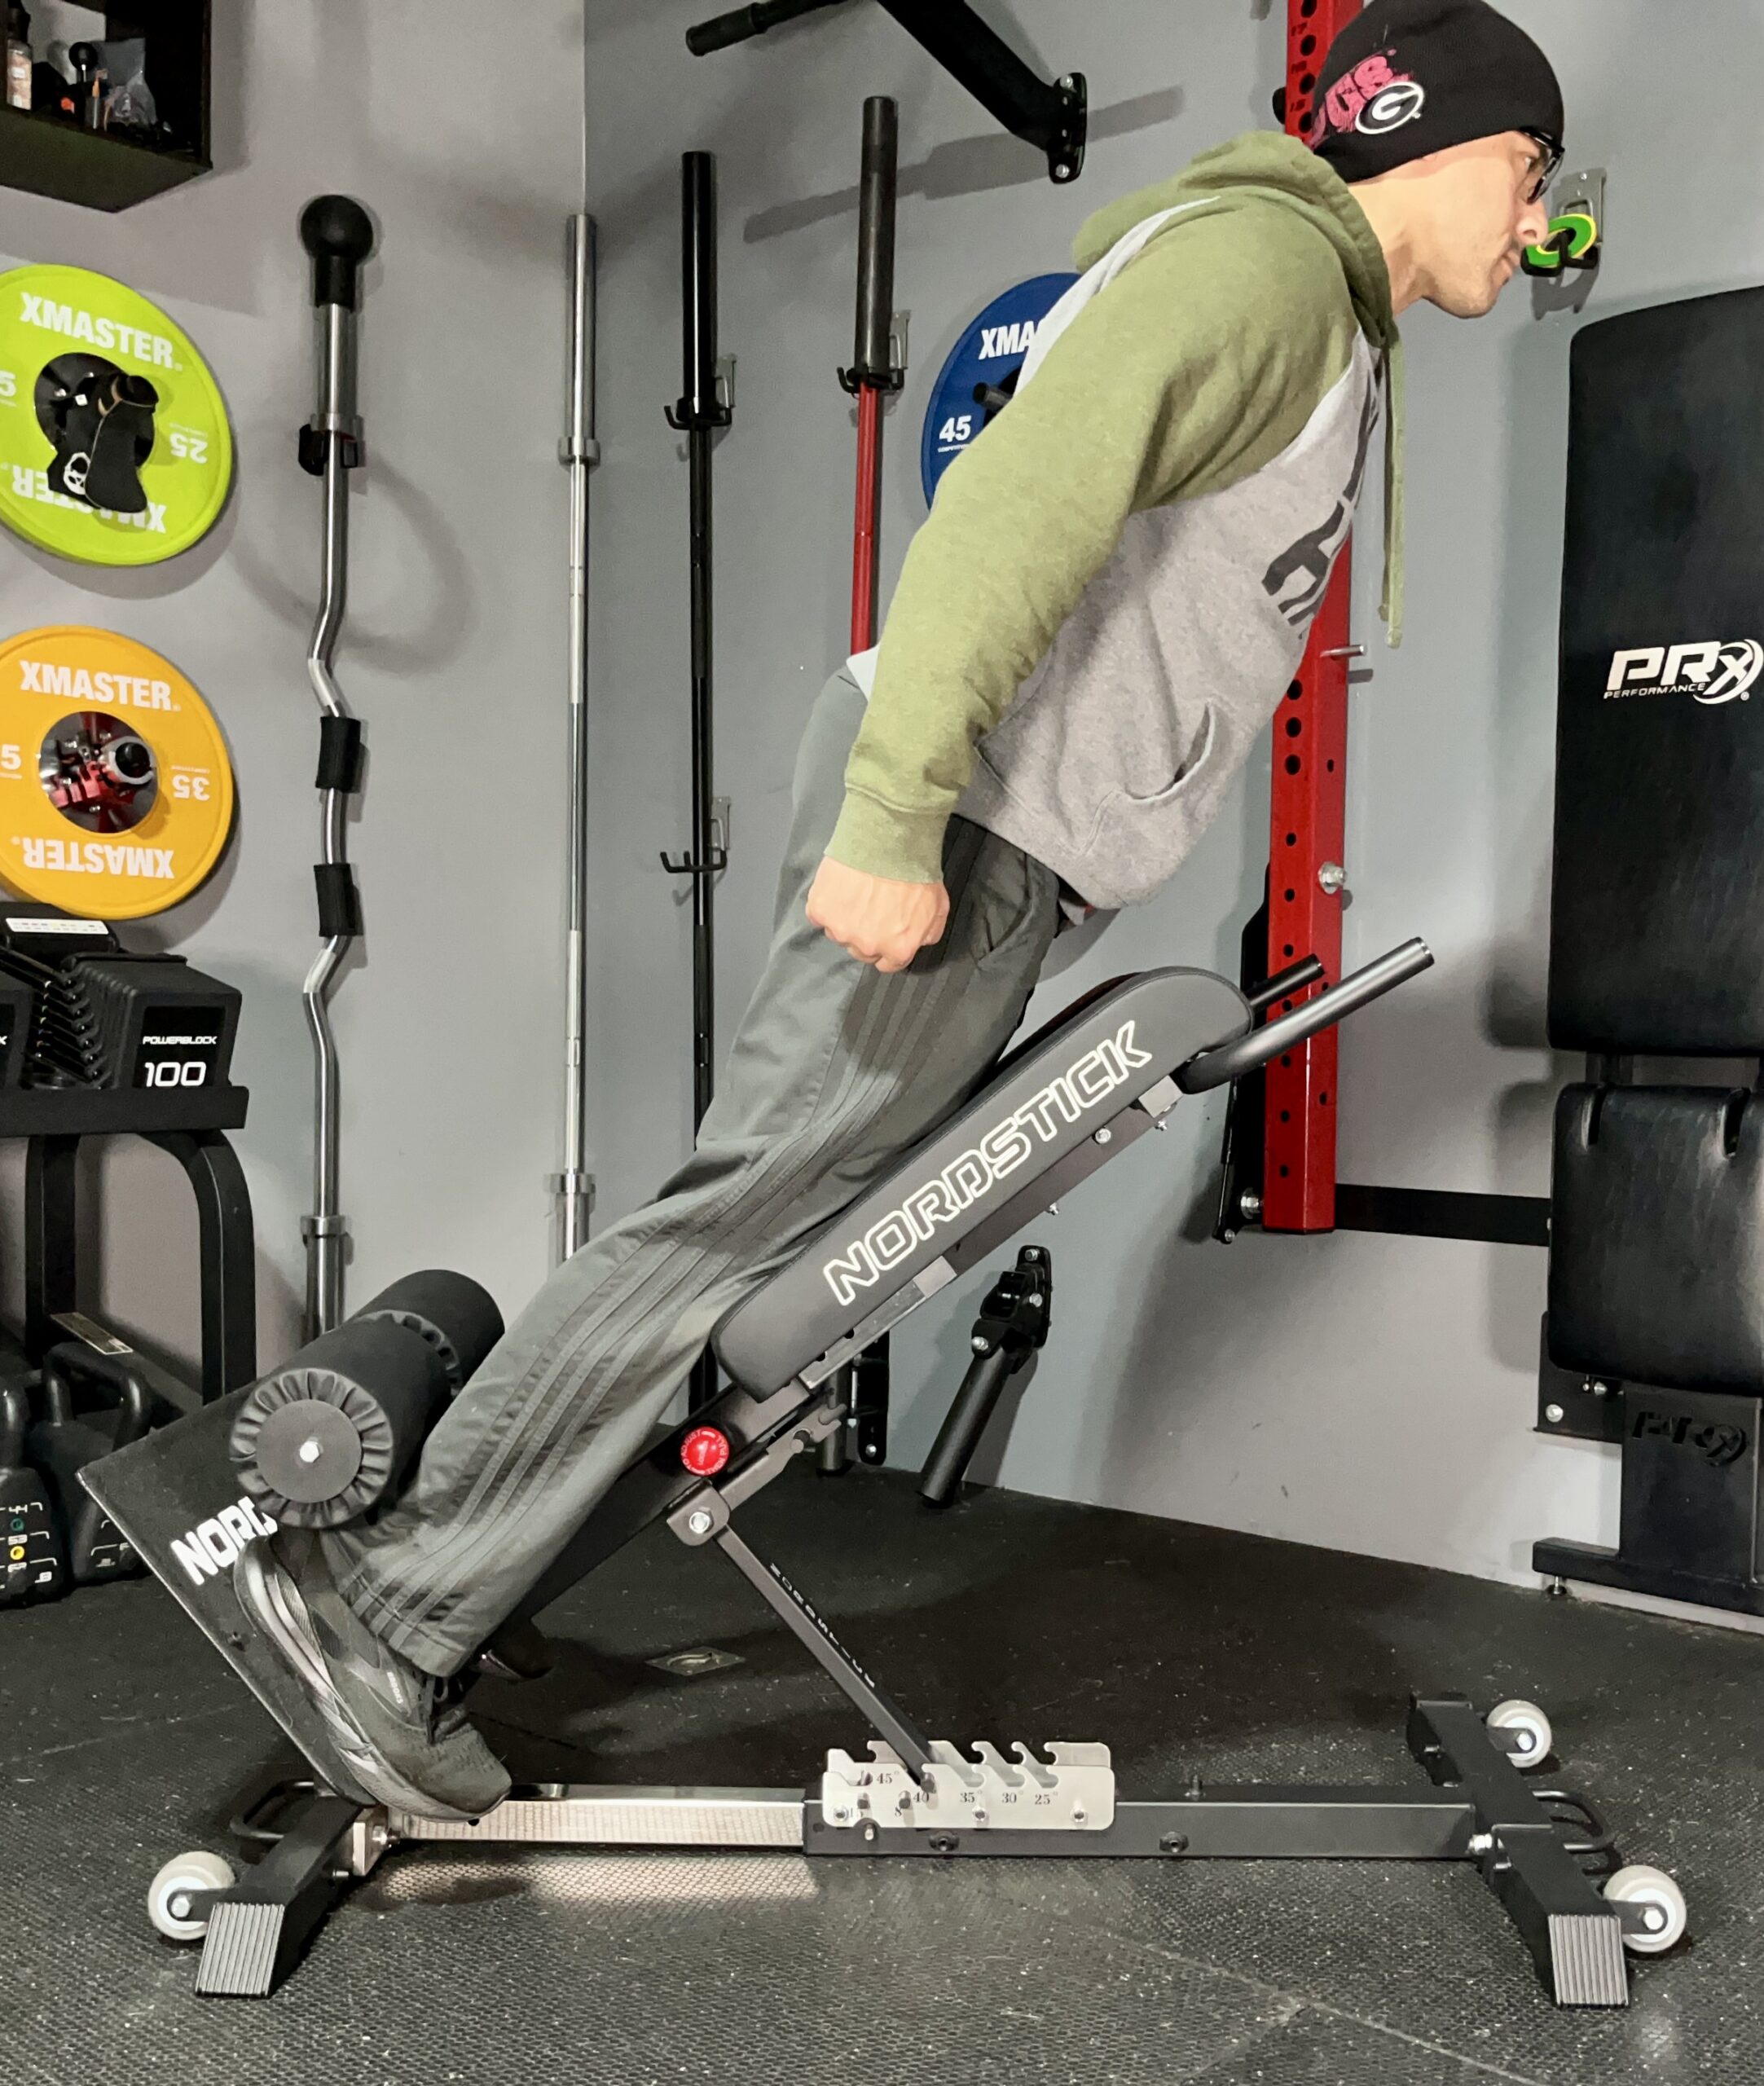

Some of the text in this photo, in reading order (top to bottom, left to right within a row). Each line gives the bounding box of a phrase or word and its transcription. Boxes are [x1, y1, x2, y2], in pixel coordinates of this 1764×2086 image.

[20, 292, 174, 369] XMASTER
[939, 415, 972, 442] 45
[169, 433, 209, 464] 25
[20, 660, 172, 711] XMASTER
[1603, 682, 1705, 699] PERFORMANCE
[172, 773, 210, 801] 35
[22, 837, 175, 879] XMASTER
[143, 1036, 218, 1045] POWERBLOCK
[144, 1061, 207, 1088] 100
[823, 1020, 1153, 1306] NORDSTICK
[680, 1429, 702, 1456] ADJUST
[716, 1434, 728, 1456] PULL
[8, 1504, 28, 1514] 44
[770, 1562, 875, 1688] NORDSTICK
